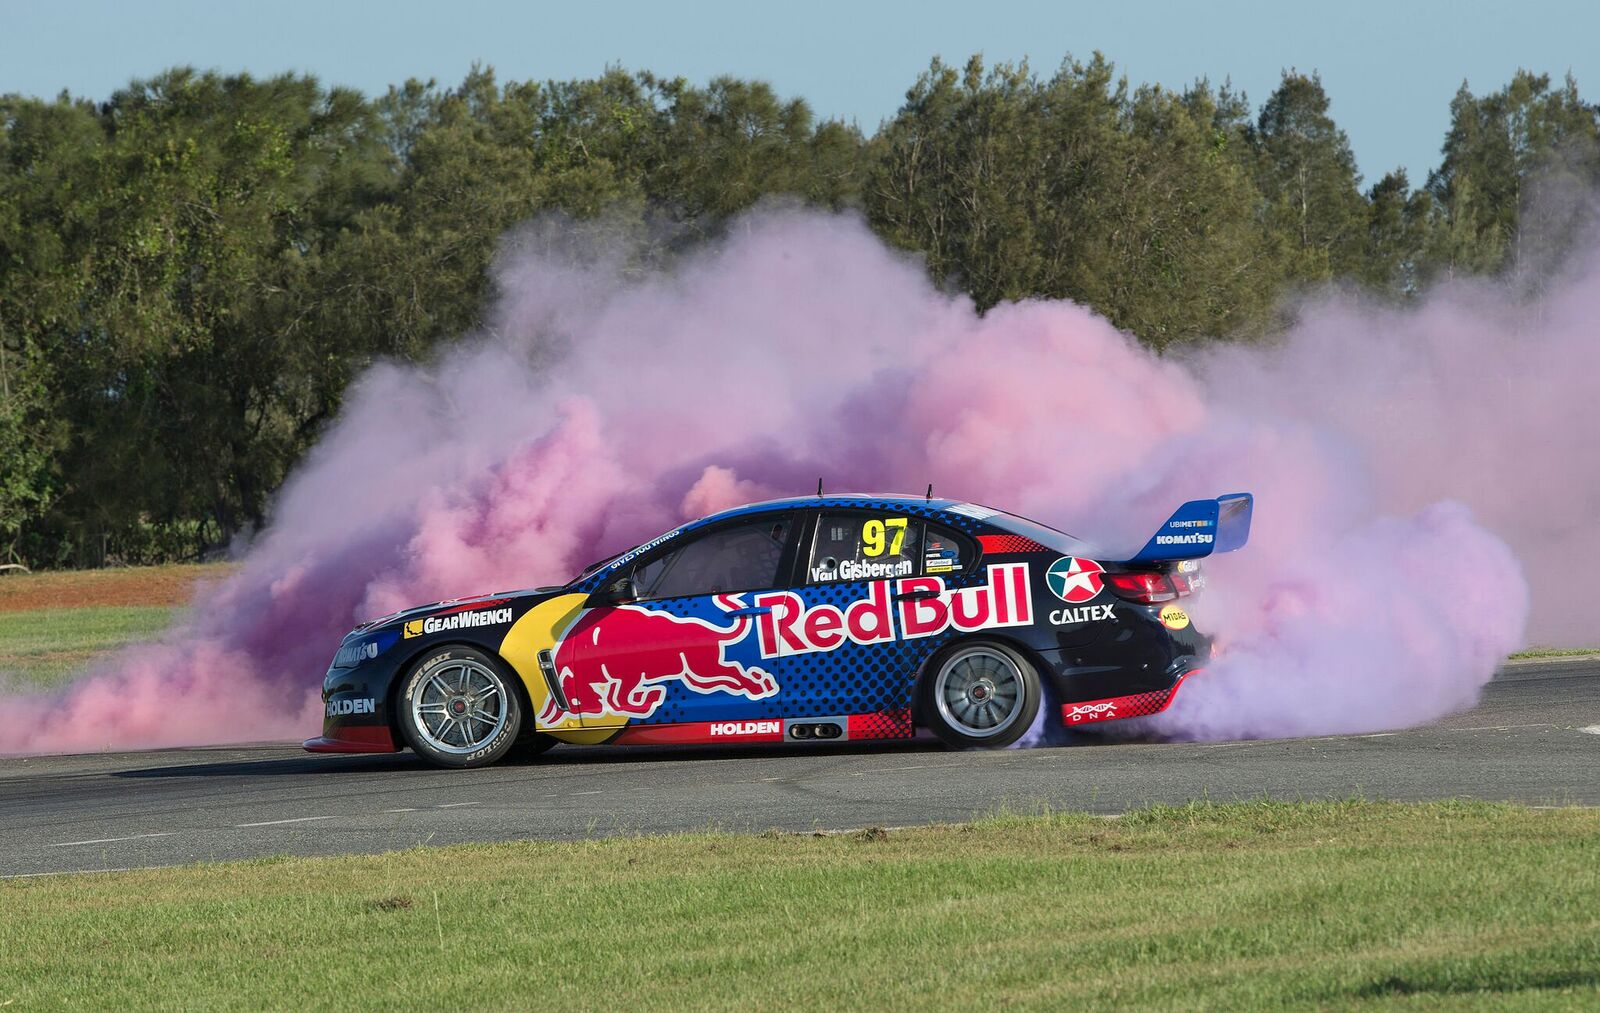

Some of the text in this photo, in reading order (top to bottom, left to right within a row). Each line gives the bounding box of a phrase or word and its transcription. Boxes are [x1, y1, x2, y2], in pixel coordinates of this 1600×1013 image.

[862, 518, 908, 556] 97
[1156, 532, 1213, 545] KOMATSU
[424, 607, 513, 634] GEARWRENCH
[755, 563, 1033, 659] Red Bull
[1049, 603, 1117, 626] CALTEX
[1162, 612, 1187, 624] MIDAS
[326, 698, 375, 718] HOLDEN
[1072, 710, 1116, 721] DNA
[711, 721, 780, 736] HOLDEN
